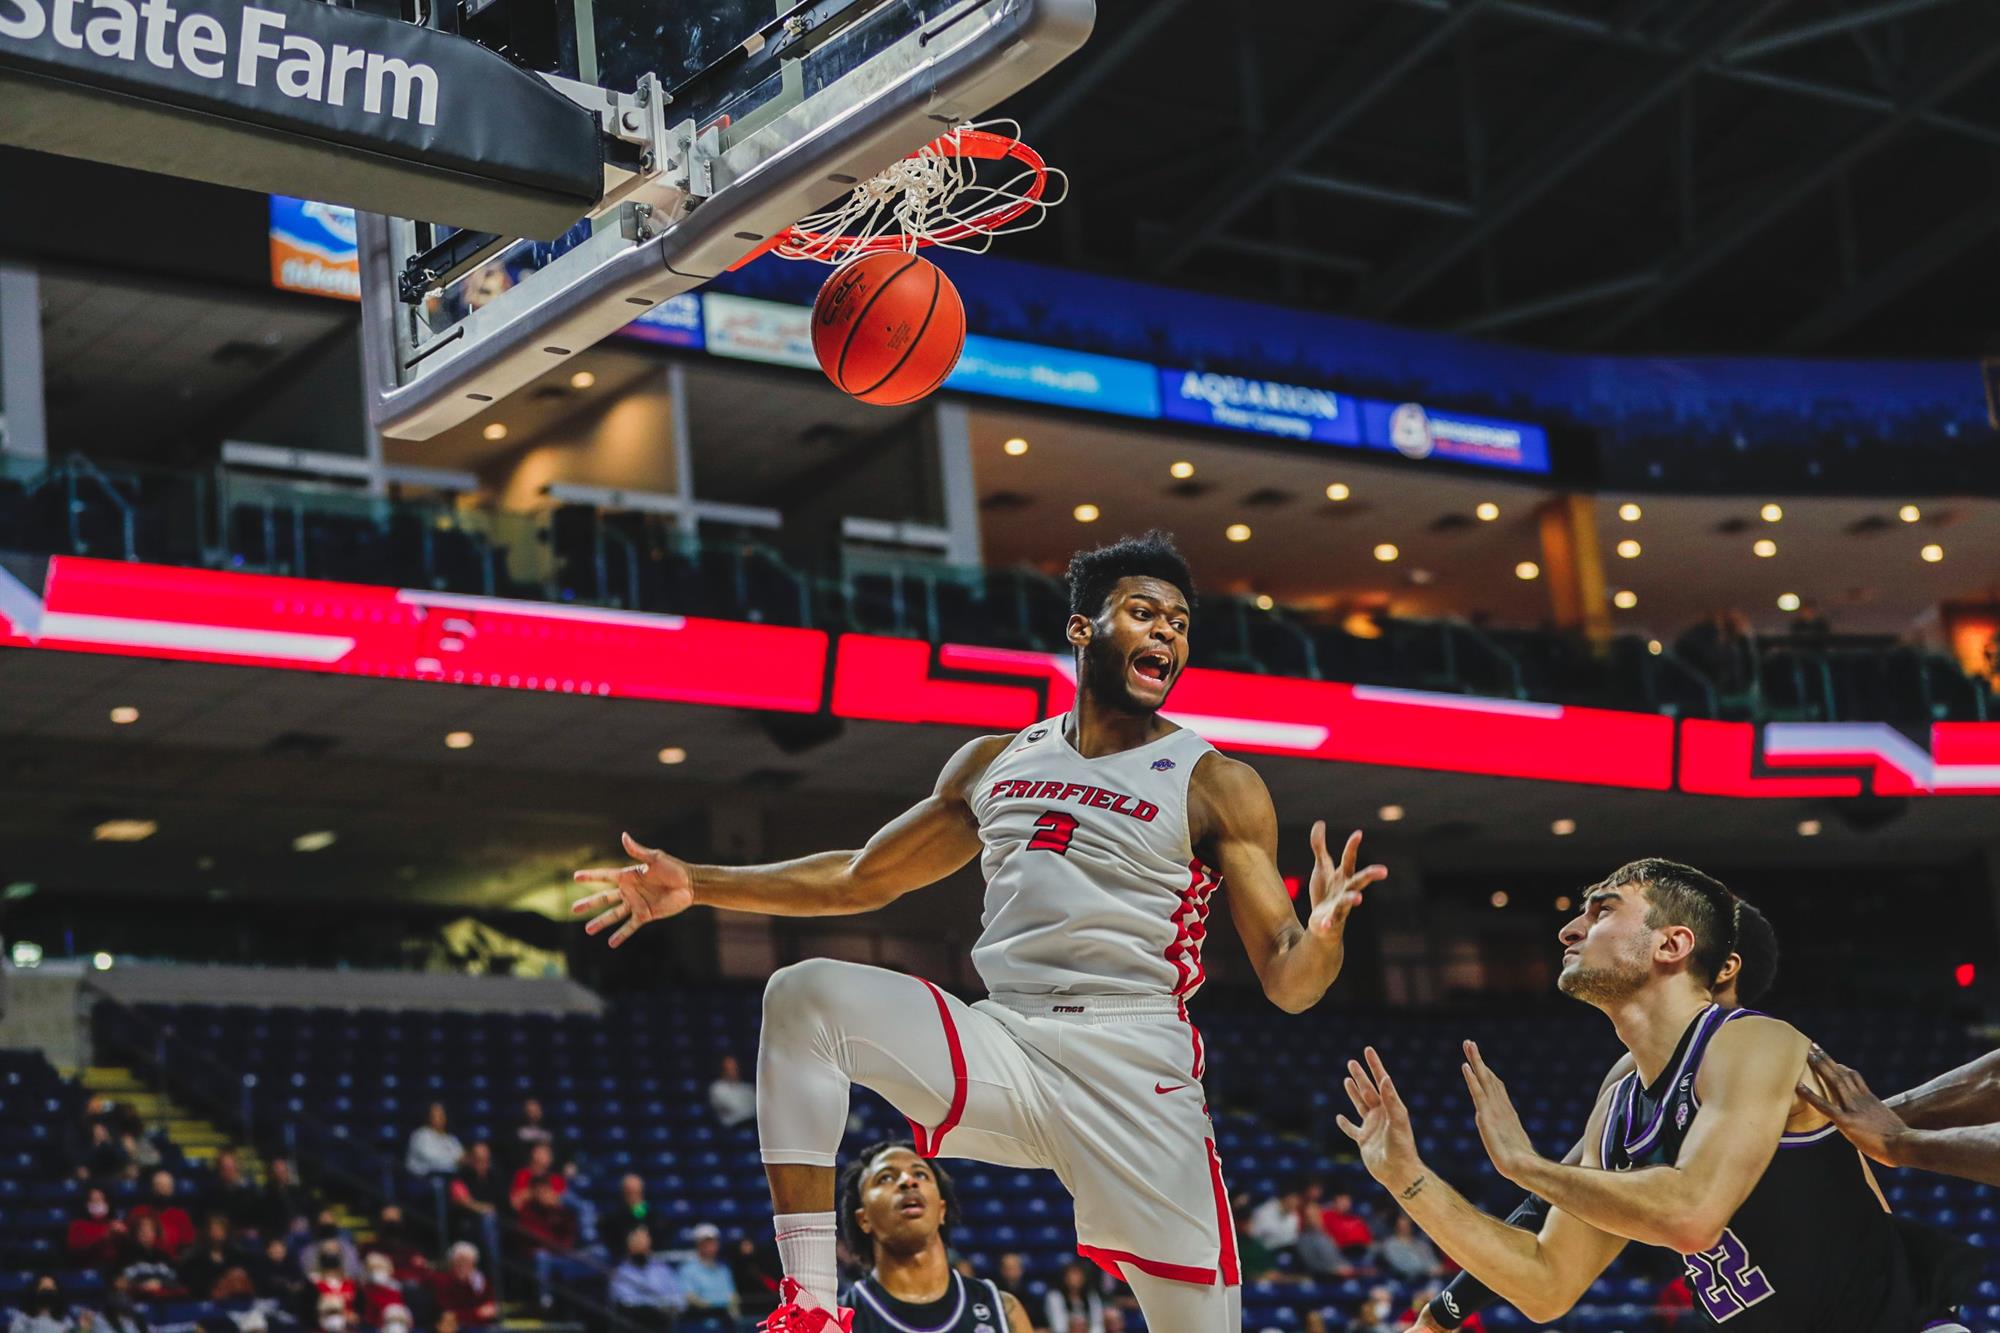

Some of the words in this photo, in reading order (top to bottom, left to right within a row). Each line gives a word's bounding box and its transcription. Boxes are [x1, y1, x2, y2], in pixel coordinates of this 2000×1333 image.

[237, 6, 440, 127] Farm
[1181, 371, 1339, 420] AQUARION
[989, 780, 1160, 823] FAIRFIELD
[1026, 810, 1080, 857] 2
[1683, 1227, 1776, 1324] 22
